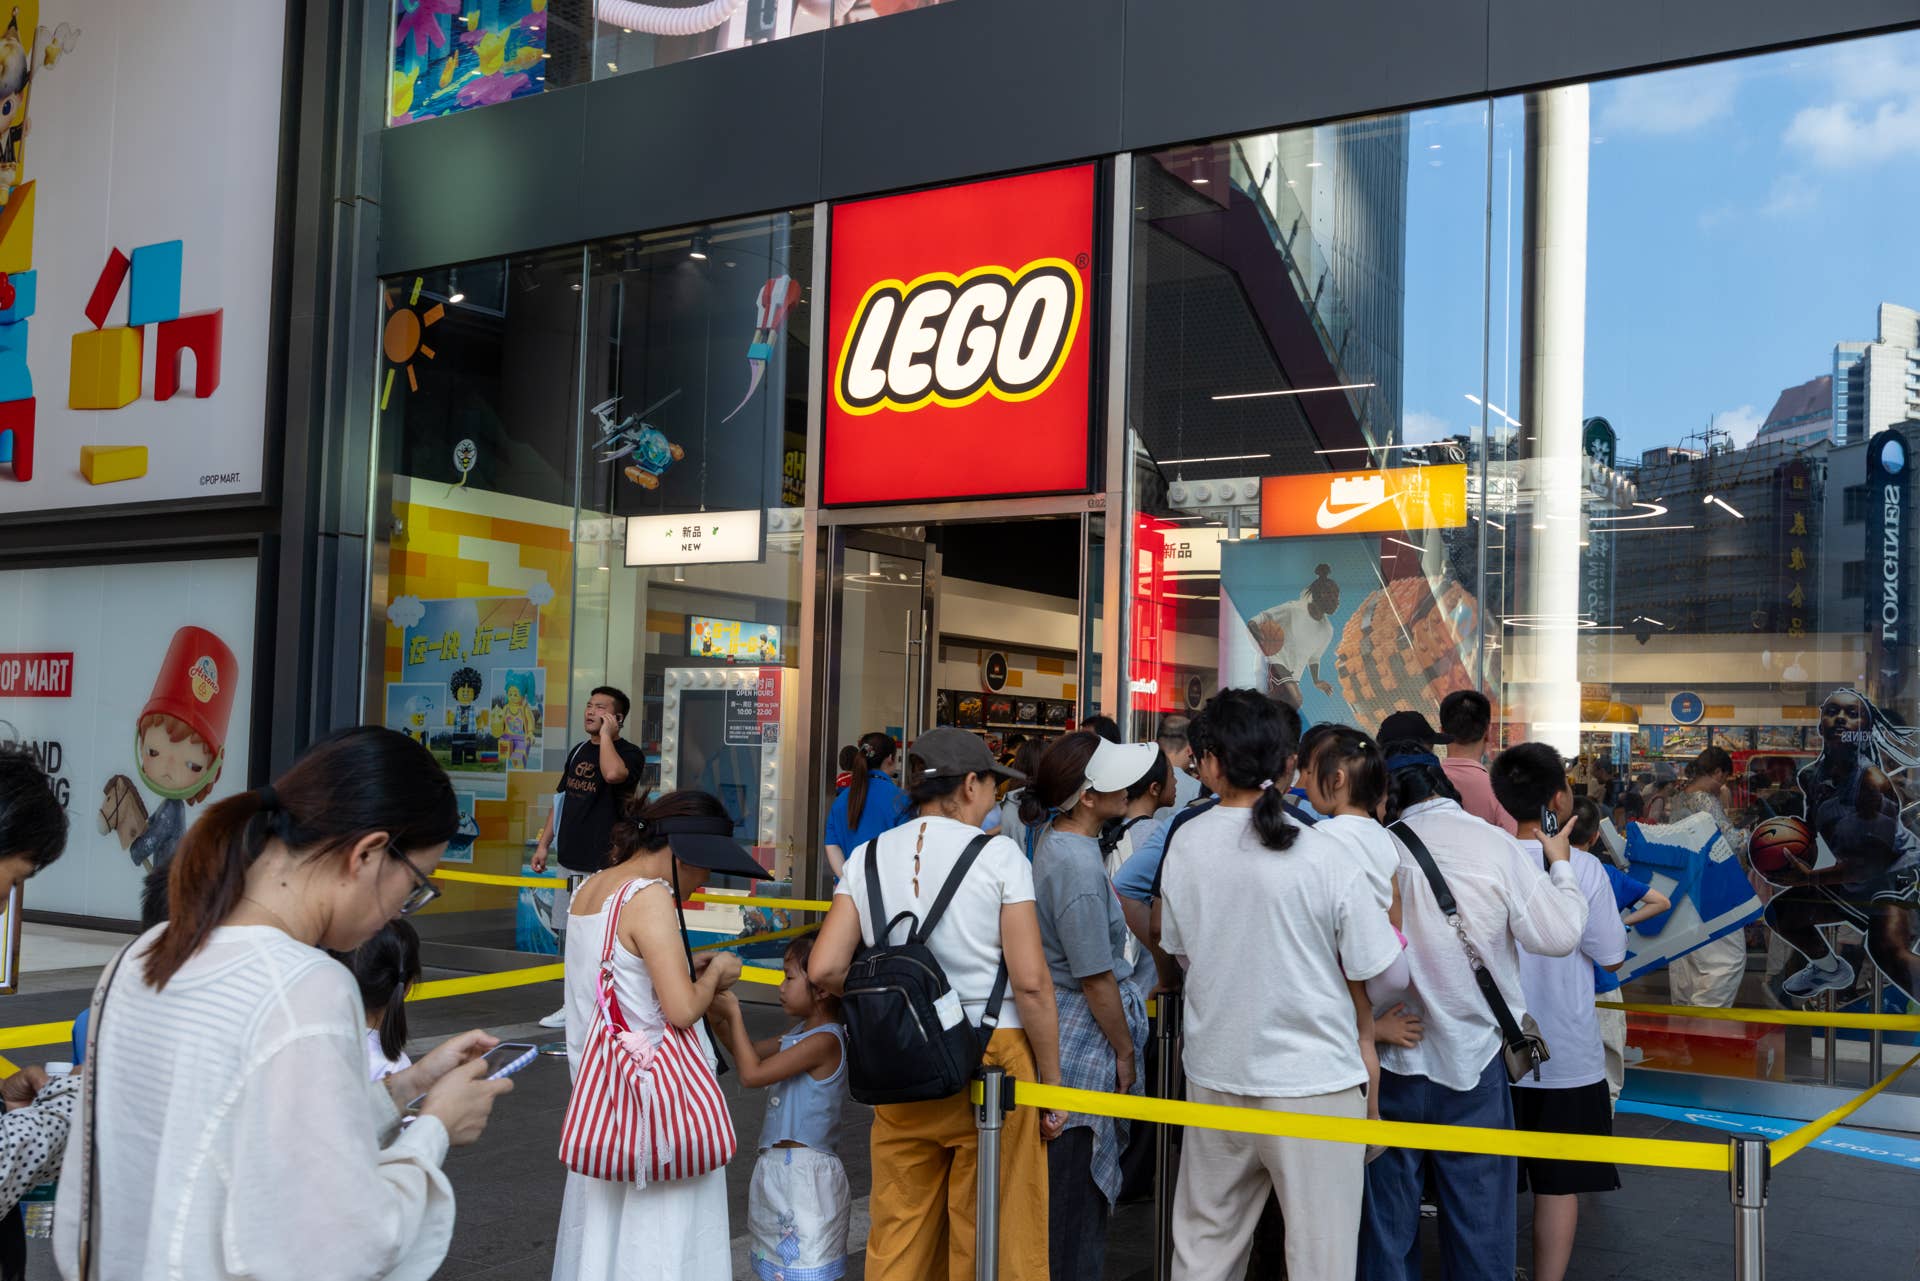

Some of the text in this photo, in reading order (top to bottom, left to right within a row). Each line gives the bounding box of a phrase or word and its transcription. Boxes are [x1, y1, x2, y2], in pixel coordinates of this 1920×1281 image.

[841, 266, 1075, 408] LEGO
[682, 525, 702, 538] 新品
[681, 543, 701, 551] NEW
[1163, 542, 1192, 558] 新品
[24, 659, 69, 691] MART
[736, 689, 774, 697] OPEN HOURS
[1819, 1139, 1889, 1156] LEGO
